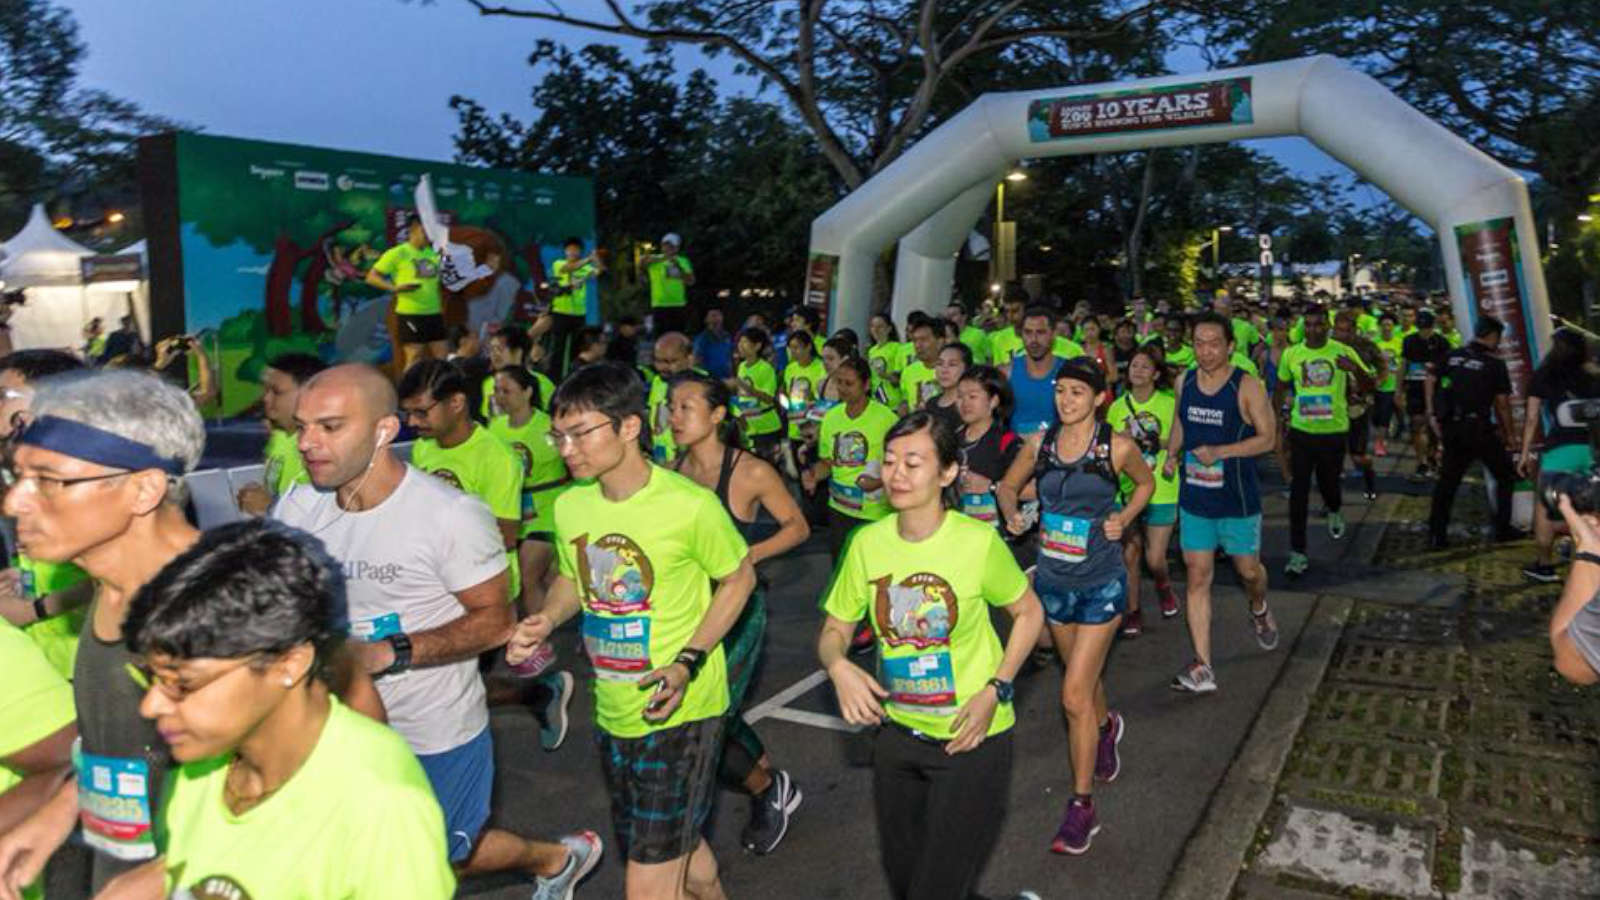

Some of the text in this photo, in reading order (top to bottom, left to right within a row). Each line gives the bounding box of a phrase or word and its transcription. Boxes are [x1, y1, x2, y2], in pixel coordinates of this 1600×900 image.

[1096, 92, 1210, 119] 10 YEARS
[357, 560, 402, 584] Page
